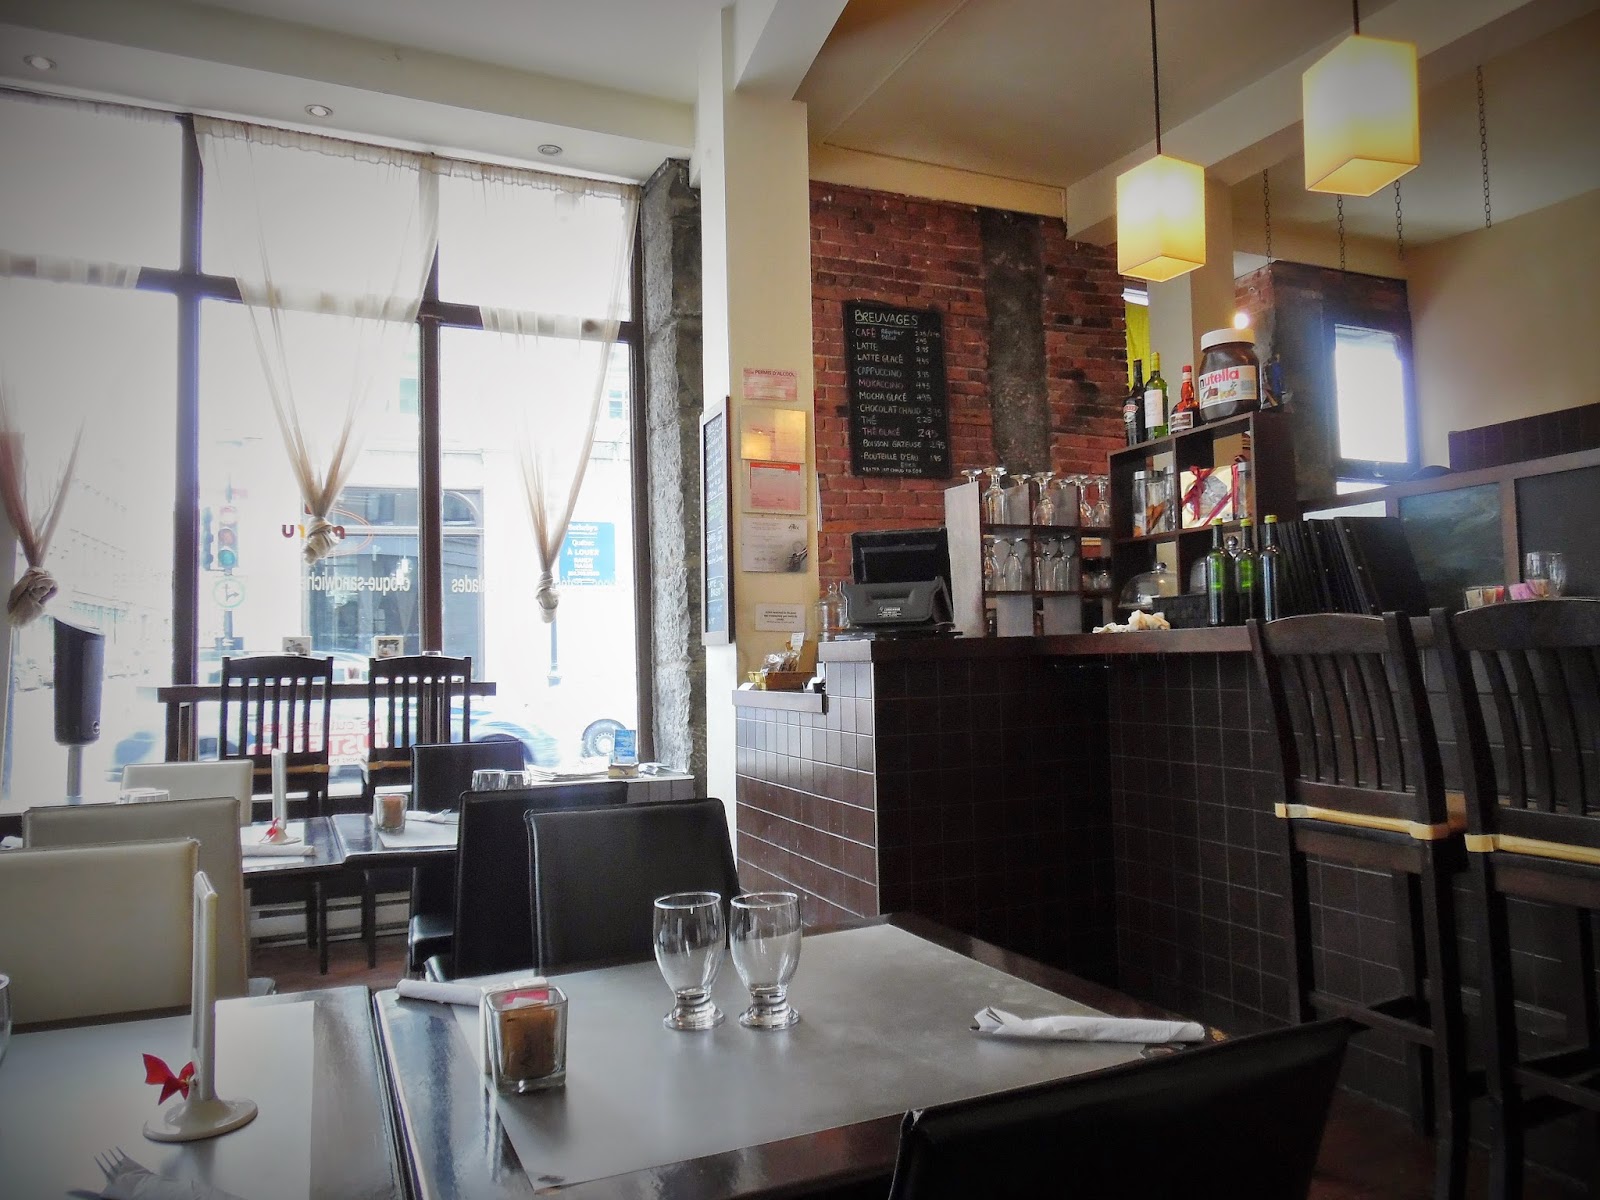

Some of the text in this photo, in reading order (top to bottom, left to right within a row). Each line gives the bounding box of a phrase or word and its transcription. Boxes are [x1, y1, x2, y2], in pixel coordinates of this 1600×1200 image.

[854, 309, 919, 326] BREUVAGES
[856, 342, 879, 352] LATTE
[857, 354, 880, 363] LATTE
[1200, 368, 1240, 388] nutella
[859, 391, 885, 400] MOCHA
[860, 404, 898, 414] CHOCOLAT
[860, 414, 877, 425] THÉ
[861, 427, 877, 436] THÉ
[862, 438, 889, 448] BOISSON
[863, 451, 898, 460] BOUTEILLE
